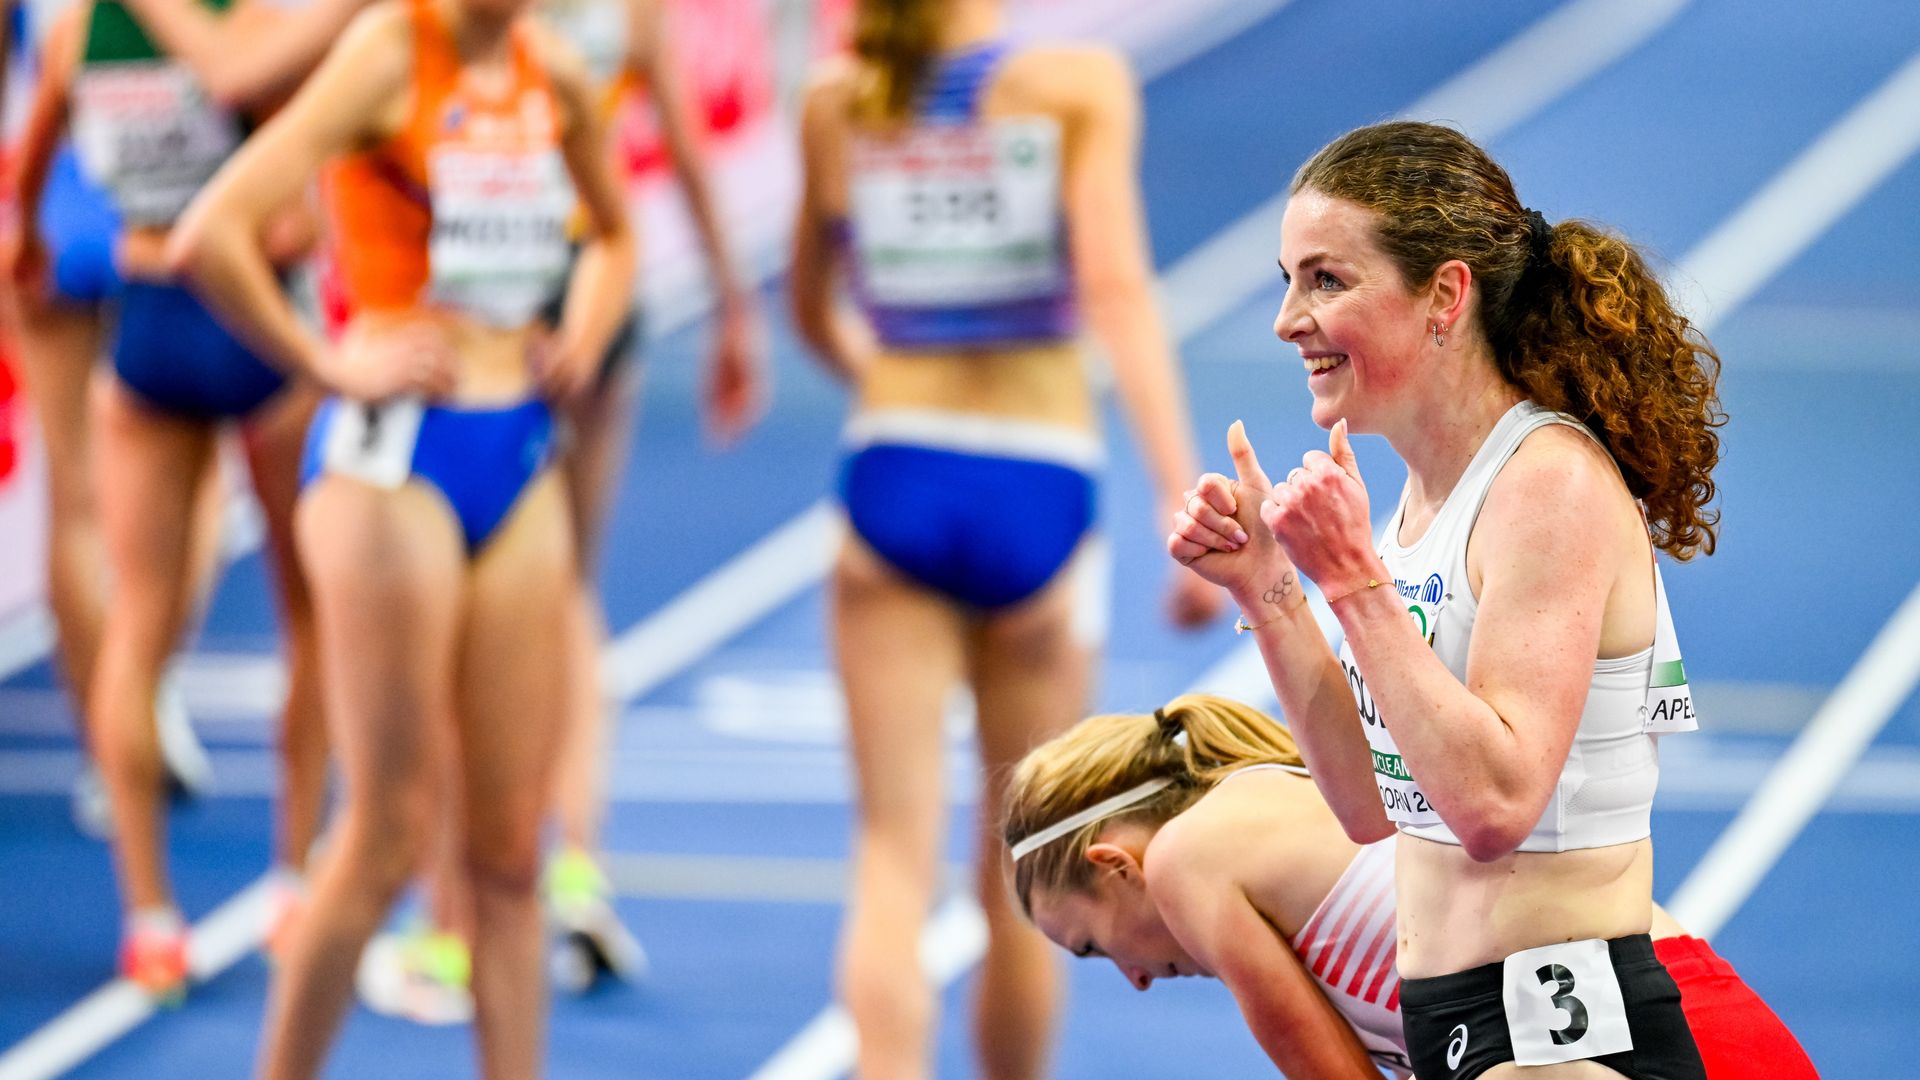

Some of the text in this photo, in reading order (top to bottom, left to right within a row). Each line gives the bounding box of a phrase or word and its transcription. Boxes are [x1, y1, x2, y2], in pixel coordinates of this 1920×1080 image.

[1651, 697, 1695, 720] APE
[1413, 791, 1435, 813] 2
[1535, 963, 1589, 1046] 3
